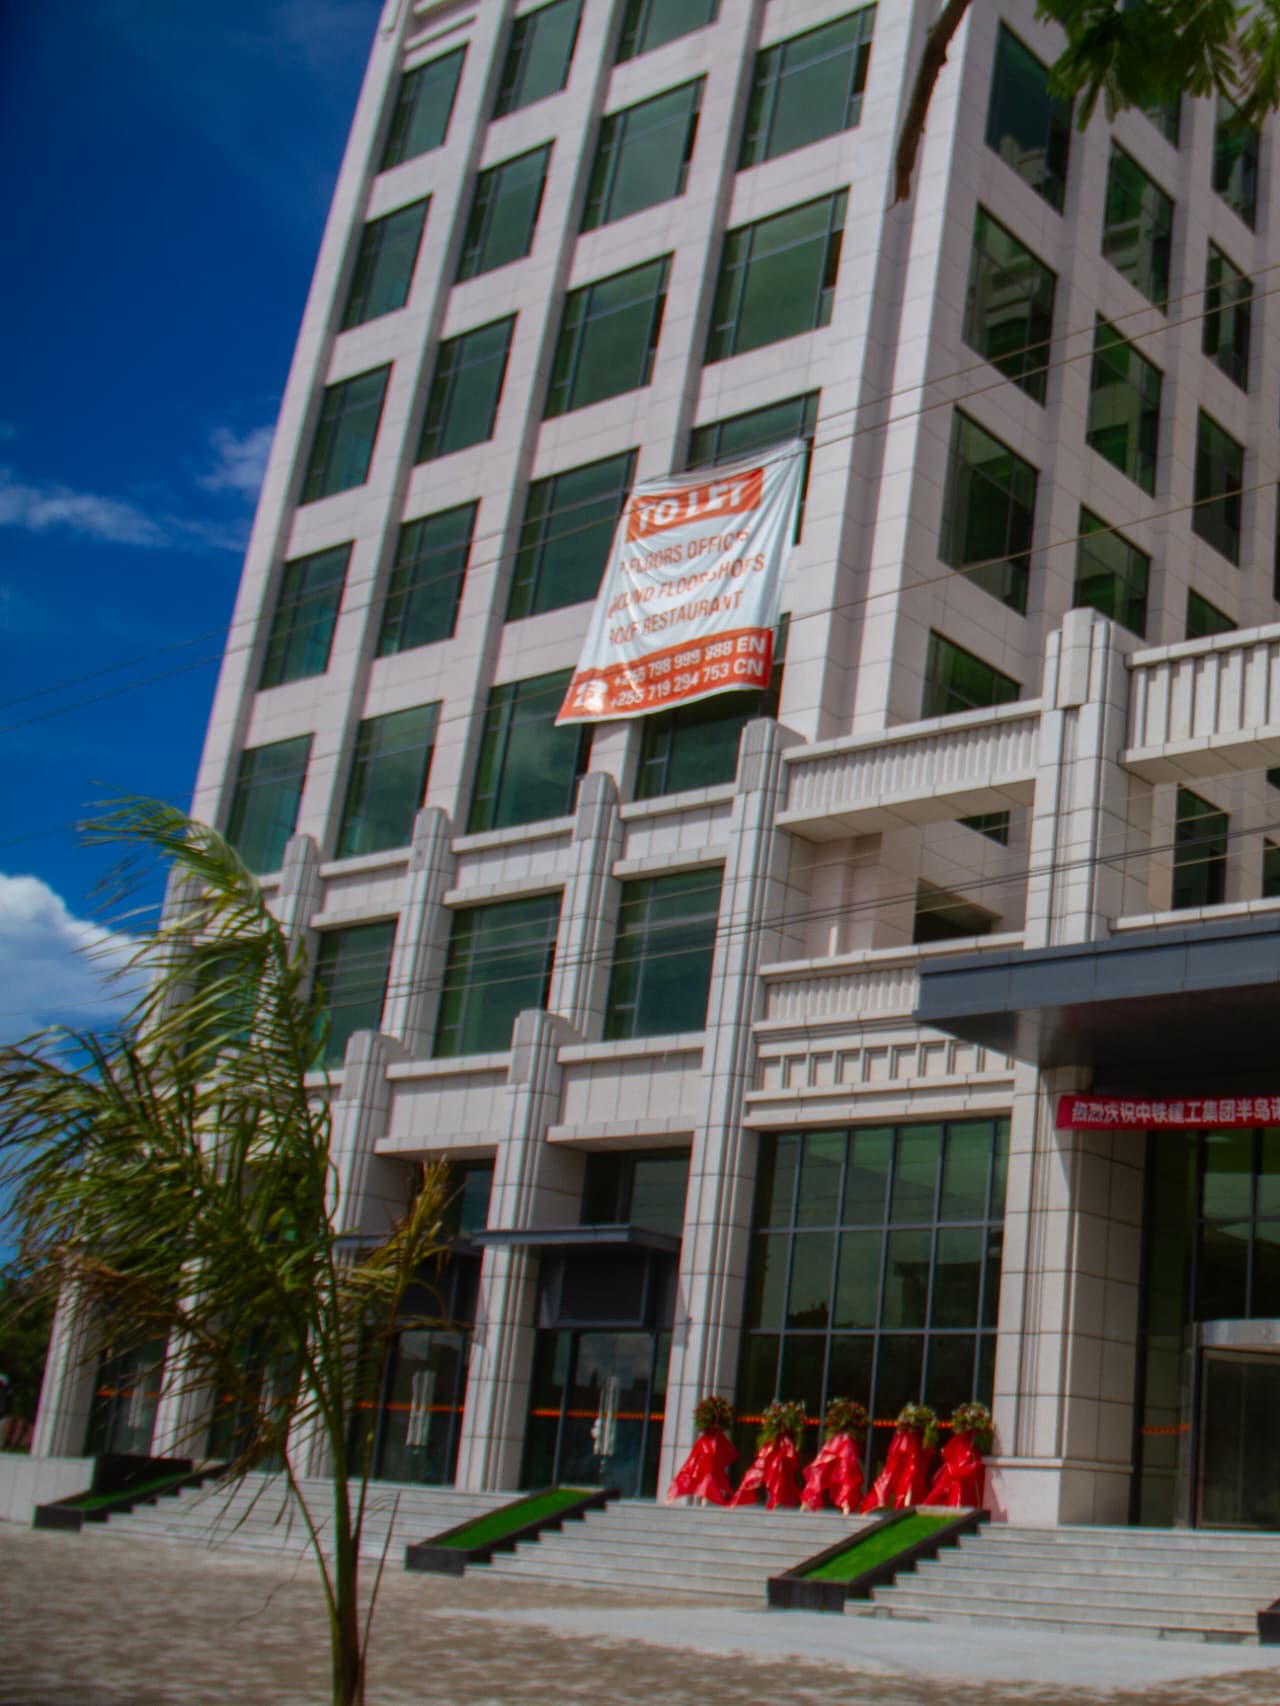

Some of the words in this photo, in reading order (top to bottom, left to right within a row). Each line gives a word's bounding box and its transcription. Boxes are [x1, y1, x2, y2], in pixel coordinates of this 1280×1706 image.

[638, 499, 679, 532] TO
[685, 480, 744, 518] LET
[737, 635, 766, 654] EN
[649, 679, 672, 701] 719
[673, 670, 699, 693] 294
[703, 661, 729, 683] 753
[734, 657, 764, 677] CN
